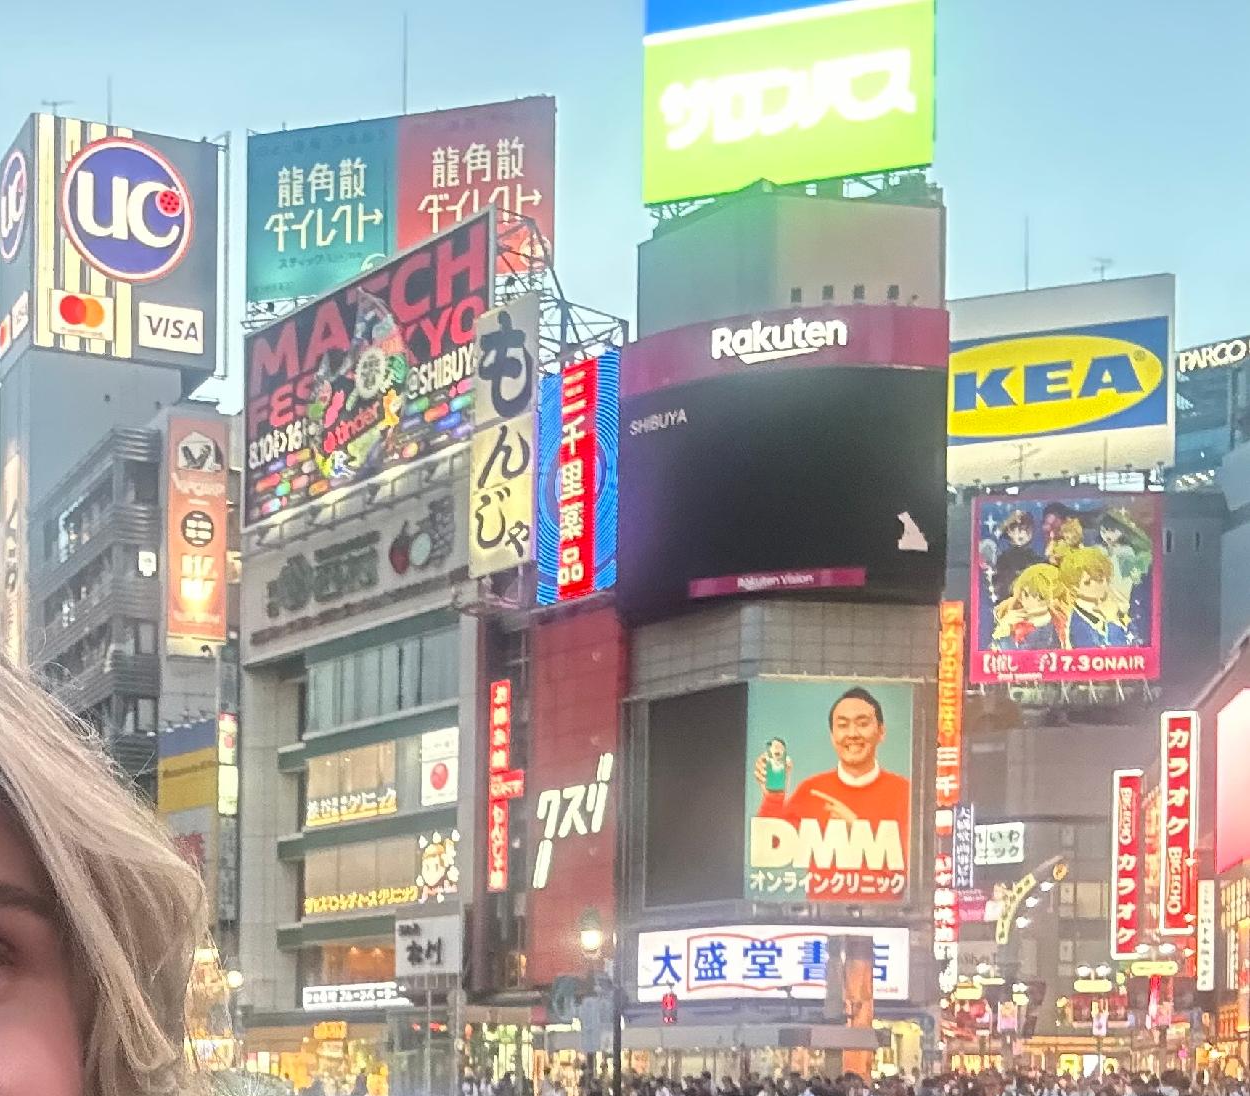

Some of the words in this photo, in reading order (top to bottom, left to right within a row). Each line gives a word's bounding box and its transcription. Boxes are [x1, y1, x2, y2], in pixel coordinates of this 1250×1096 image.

[277, 156, 368, 208] 龍角散
[432, 135, 526, 188] 龍角散
[263, 203, 384, 252] ダイレクト
[144, 314, 199, 342] VISA
[711, 317, 847, 361] Rakuten
[406, 342, 478, 400] @SHIBUY
[954, 354, 1145, 412] KEA
[1179, 339, 1247, 373] PARCO
[475, 310, 534, 558] もんじゃ
[630, 408, 688, 436] SHIBUYA
[558, 369, 588, 586] 三千里薬品
[1166, 728, 1190, 836] カラオケ
[533, 752, 614, 889] クスリ
[750, 816, 904, 871] DMM
[749, 870, 905, 895] オンラインクリニック
[1117, 854, 1137, 945] カラオケ
